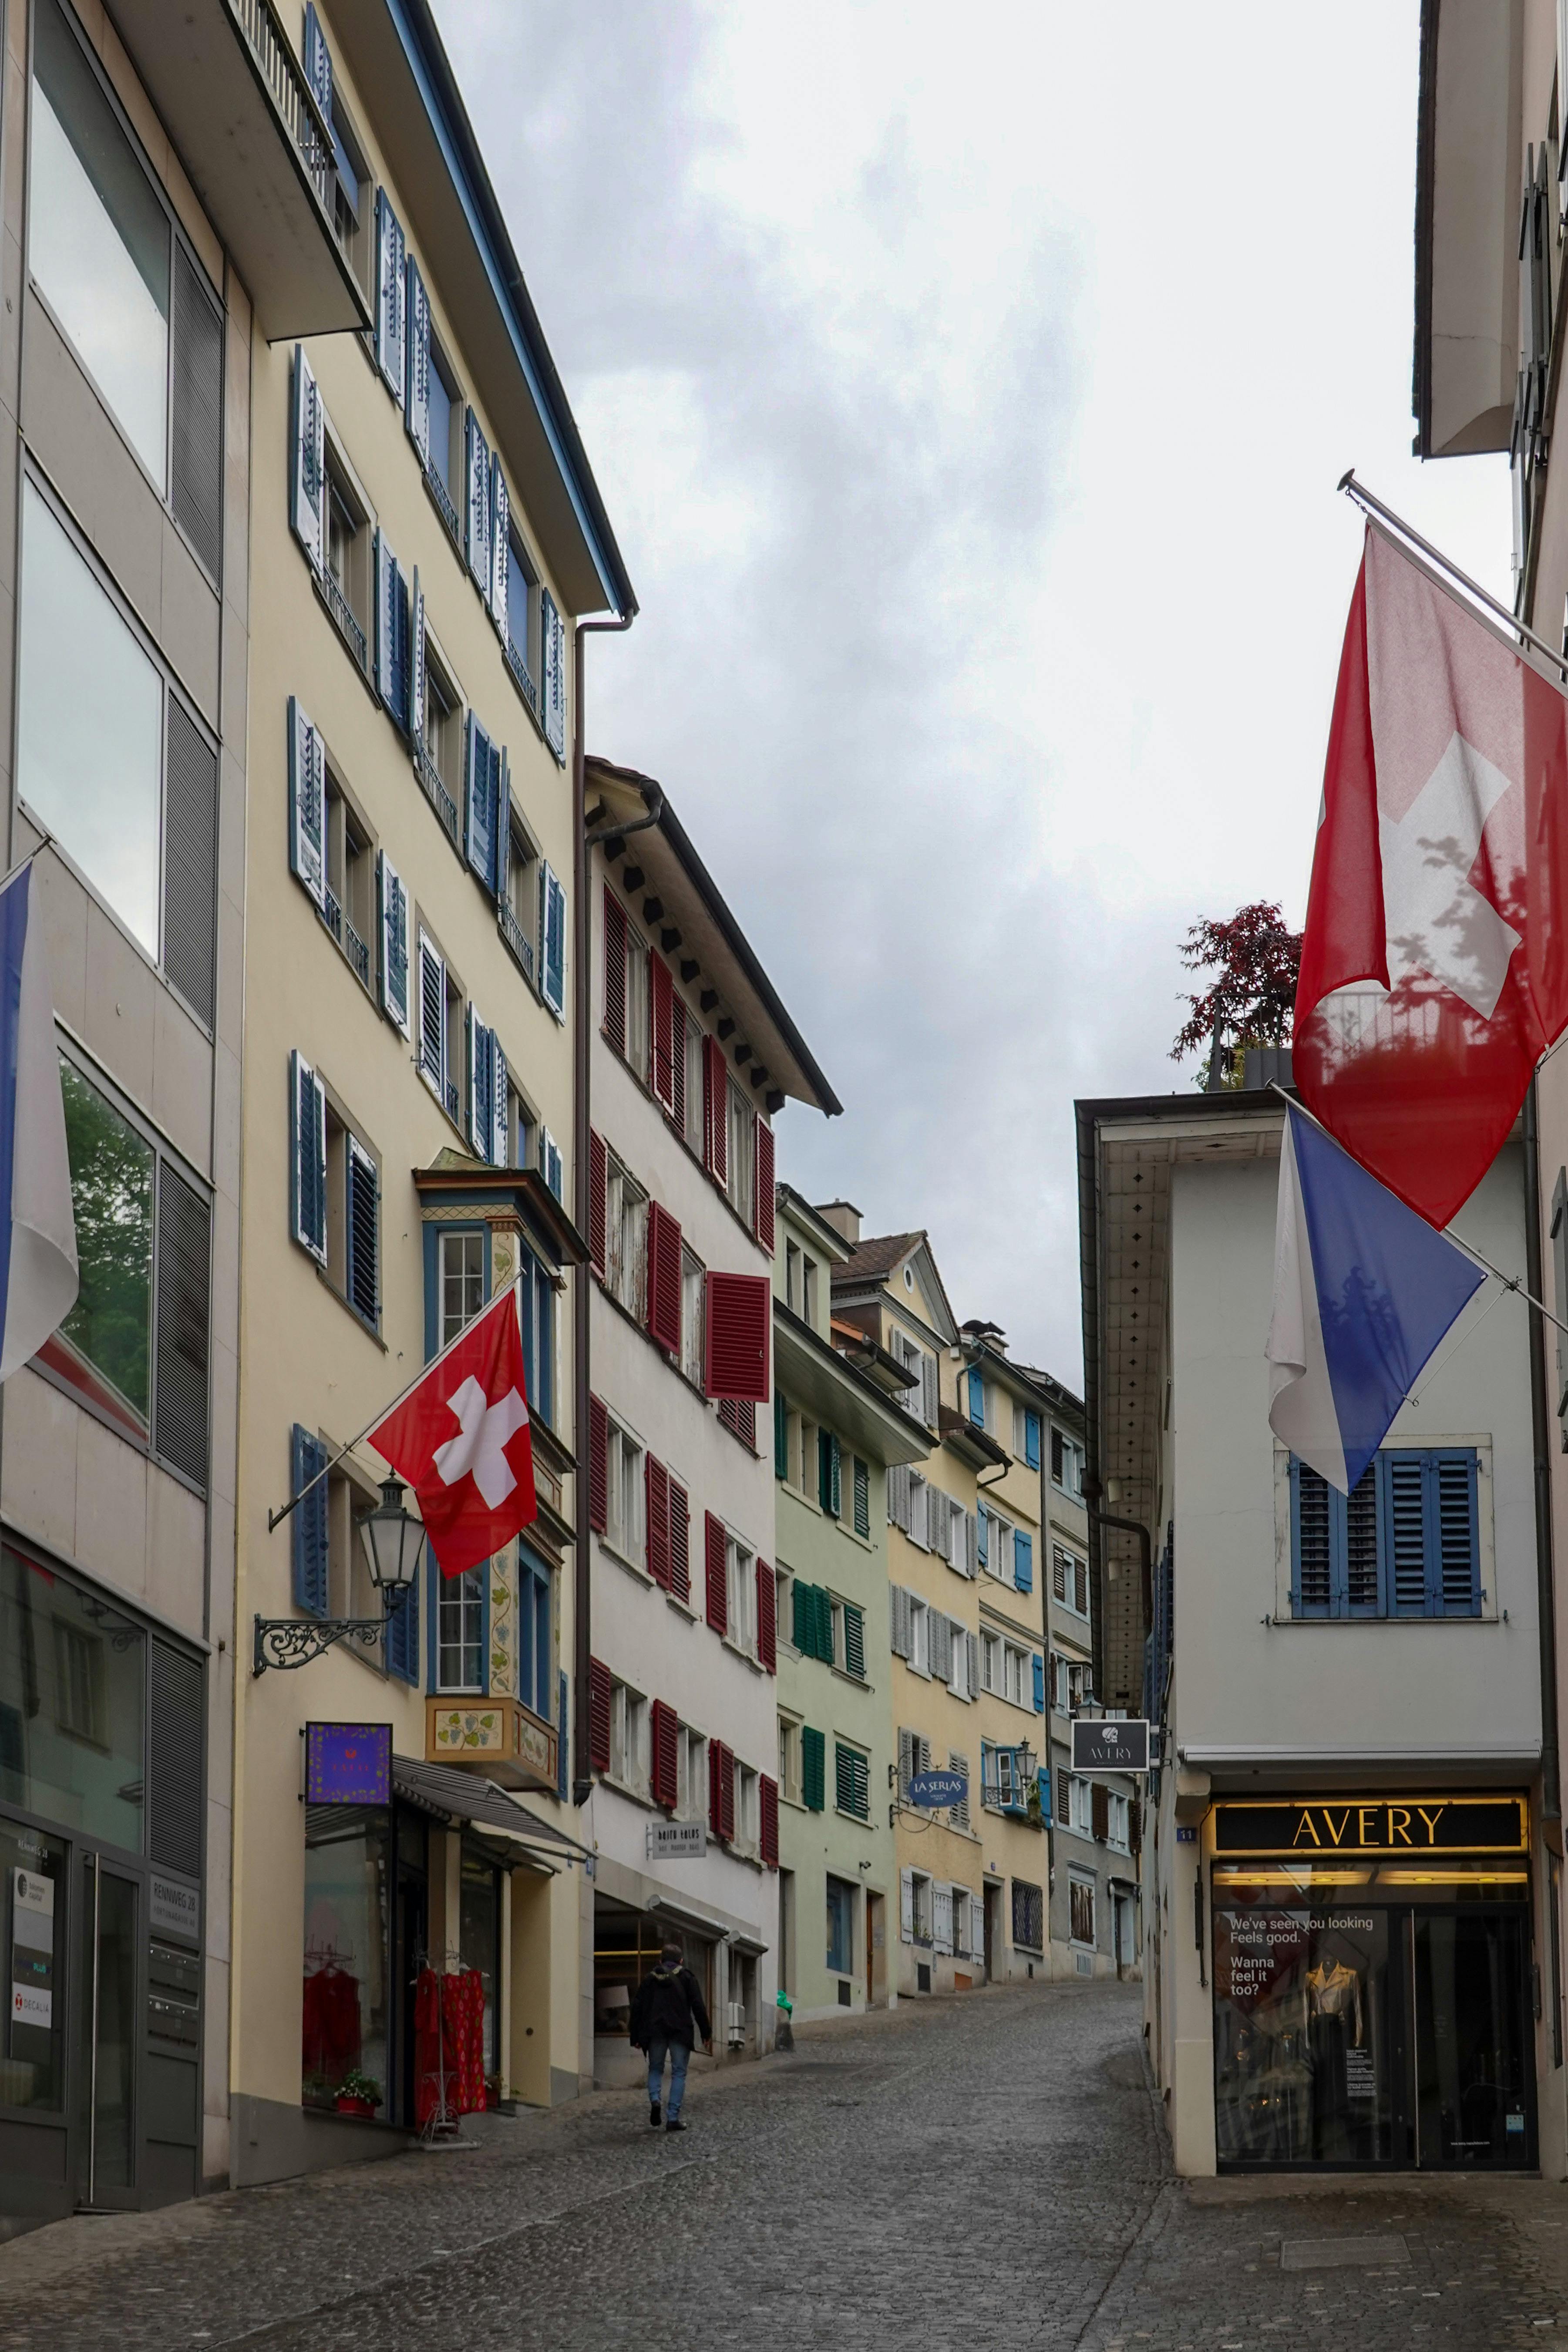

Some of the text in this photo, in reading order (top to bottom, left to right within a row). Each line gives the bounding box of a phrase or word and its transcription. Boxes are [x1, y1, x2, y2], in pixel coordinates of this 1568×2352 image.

[1089, 1748, 1131, 1759] AVERY
[915, 1782, 927, 1793] LA
[1293, 1808, 1443, 1845] AVERY
[1181, 1830, 1192, 1839] 11
[155, 1882, 195, 1911] RENNWEG 28
[1230, 1916, 1373, 1931] We've seen you looking
[1230, 1931, 1301, 1945] Feels good.
[1230, 1957, 1274, 1968] Wanna
[1231, 1970, 1267, 1981] feel it
[1231, 1984, 1258, 1995] too?
[24, 1999, 49, 2013] DECALIA
